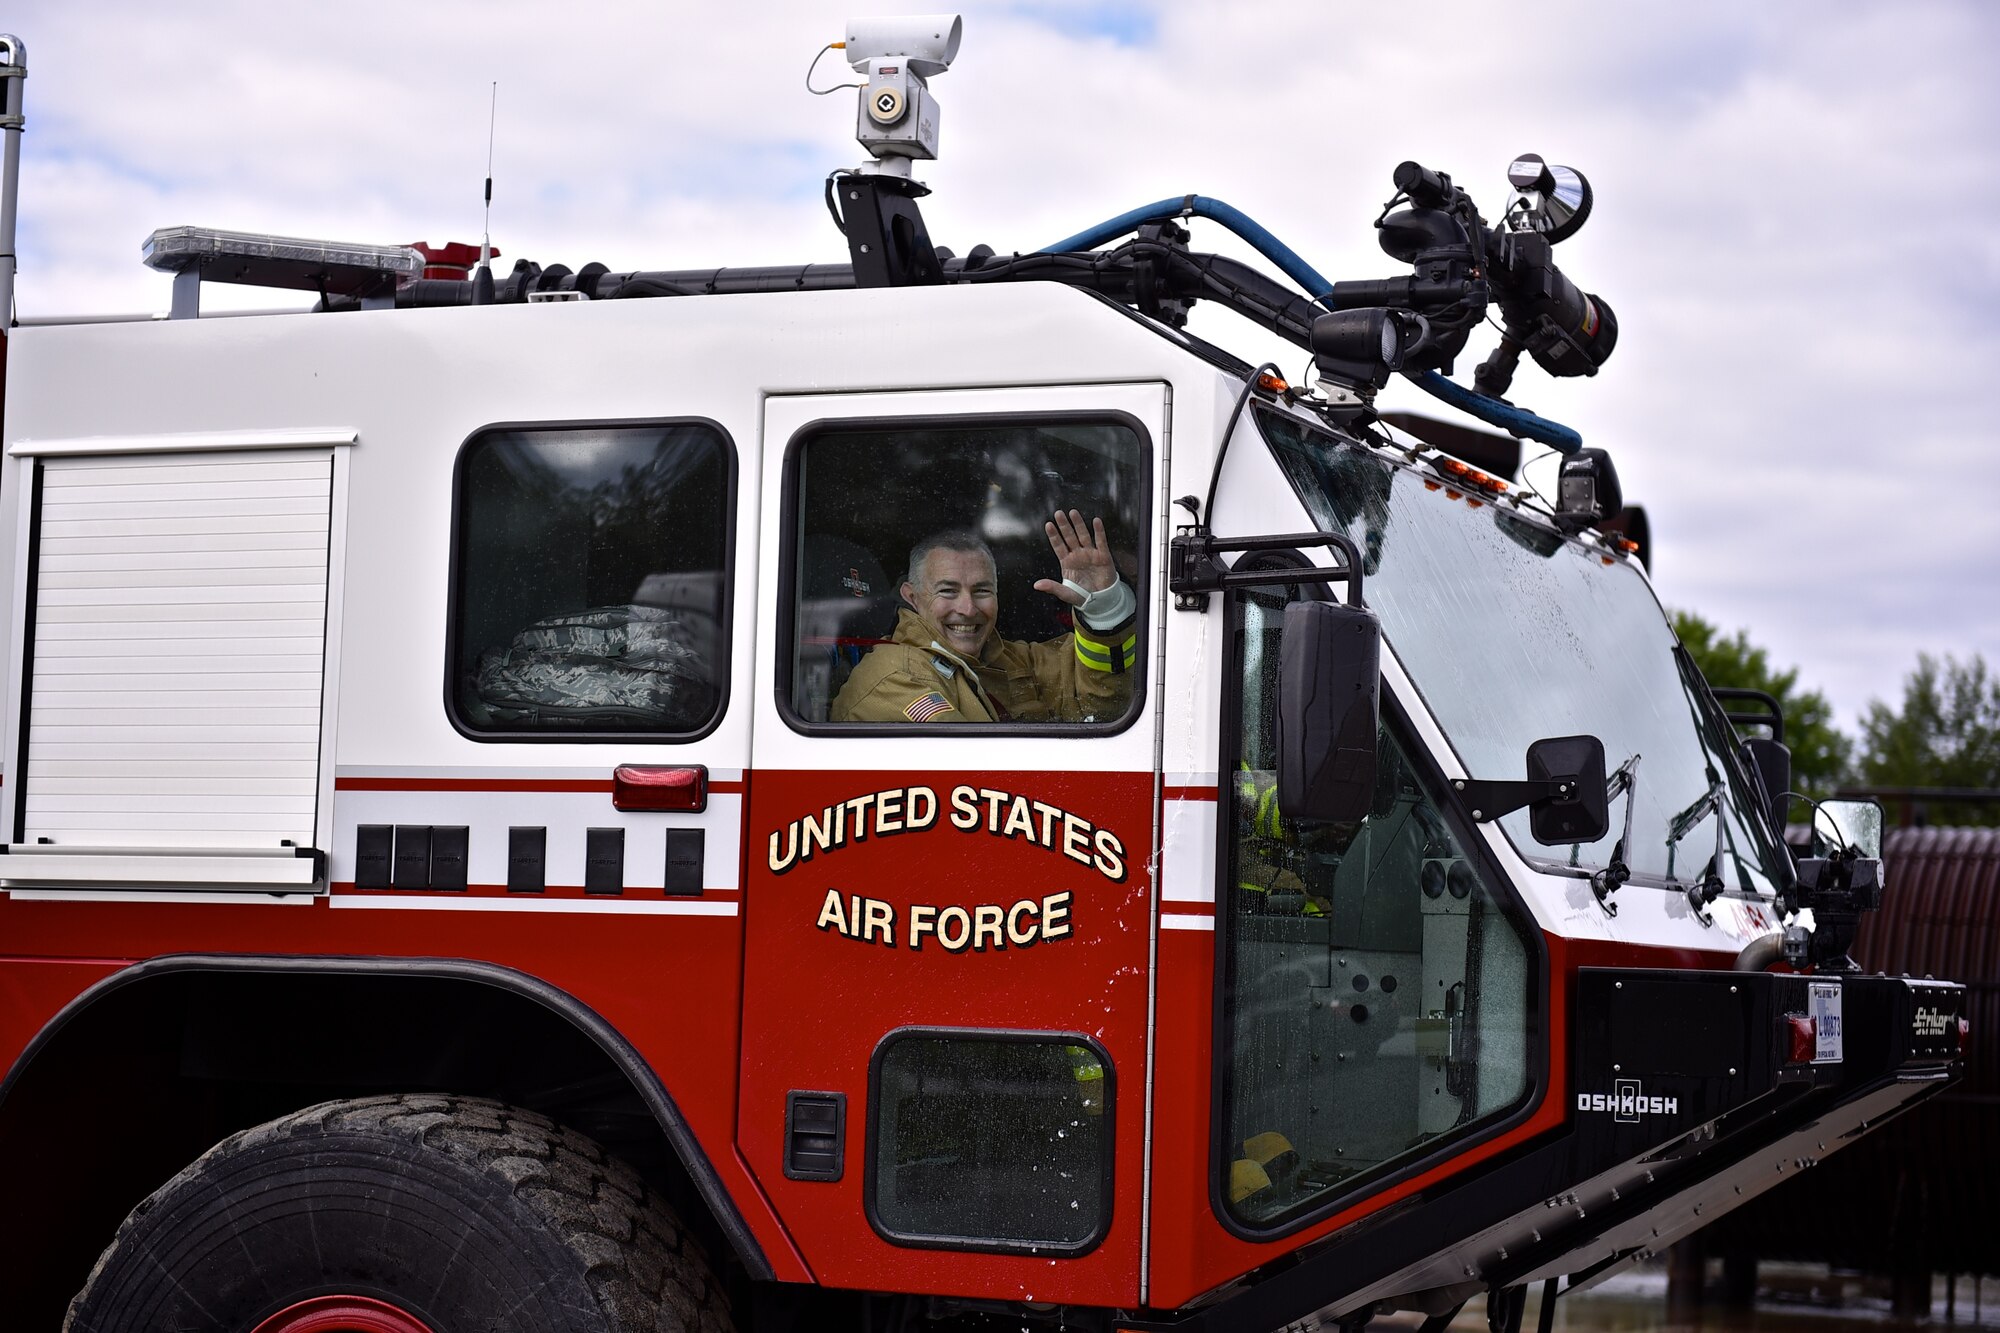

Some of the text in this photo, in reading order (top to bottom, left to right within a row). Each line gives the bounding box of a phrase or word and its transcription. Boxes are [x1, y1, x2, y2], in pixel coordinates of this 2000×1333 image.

[767, 784, 1128, 882] UNITED STATES
[816, 888, 1074, 953] AIR FORCE
[1577, 1093, 1678, 1115] OSHKOSH
